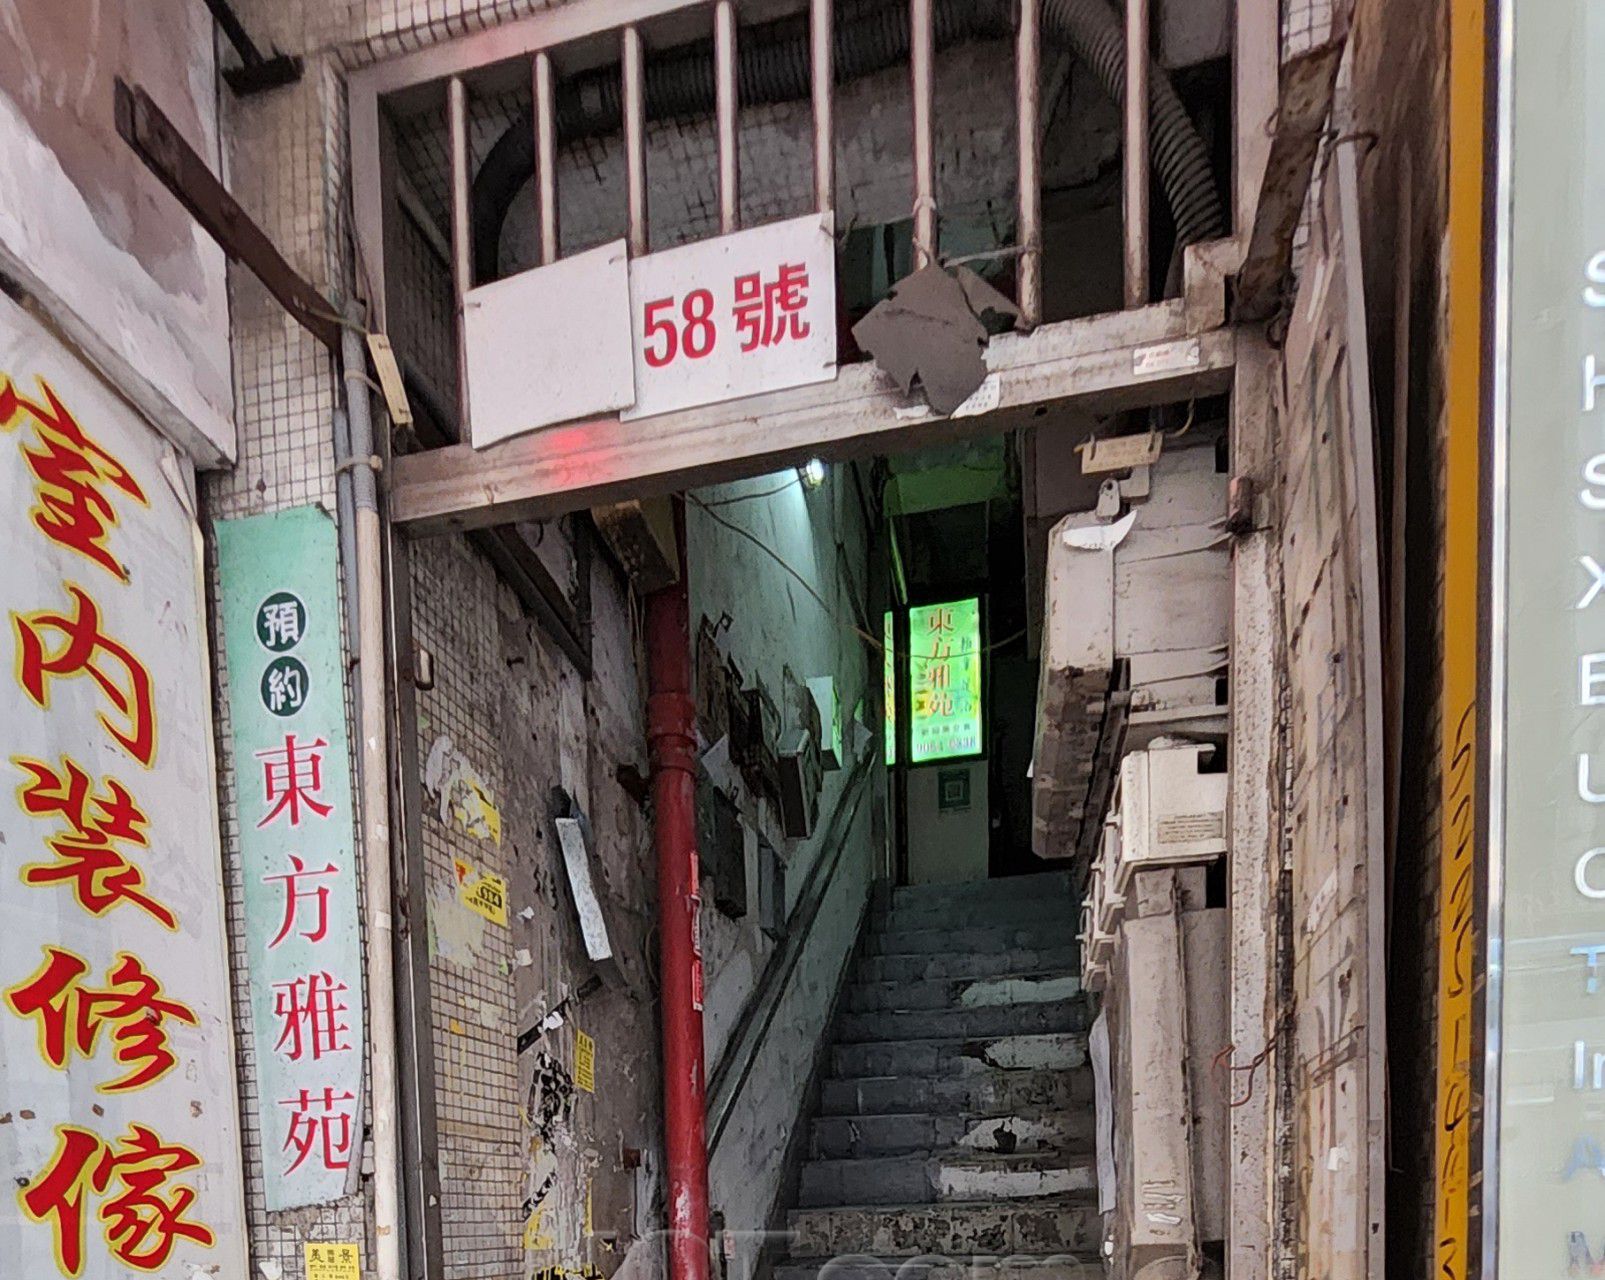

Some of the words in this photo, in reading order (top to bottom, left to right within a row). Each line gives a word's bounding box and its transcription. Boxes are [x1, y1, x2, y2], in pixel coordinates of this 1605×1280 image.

[258, 593, 307, 714] 預約
[254, 733, 359, 1177] 東方雅苑
